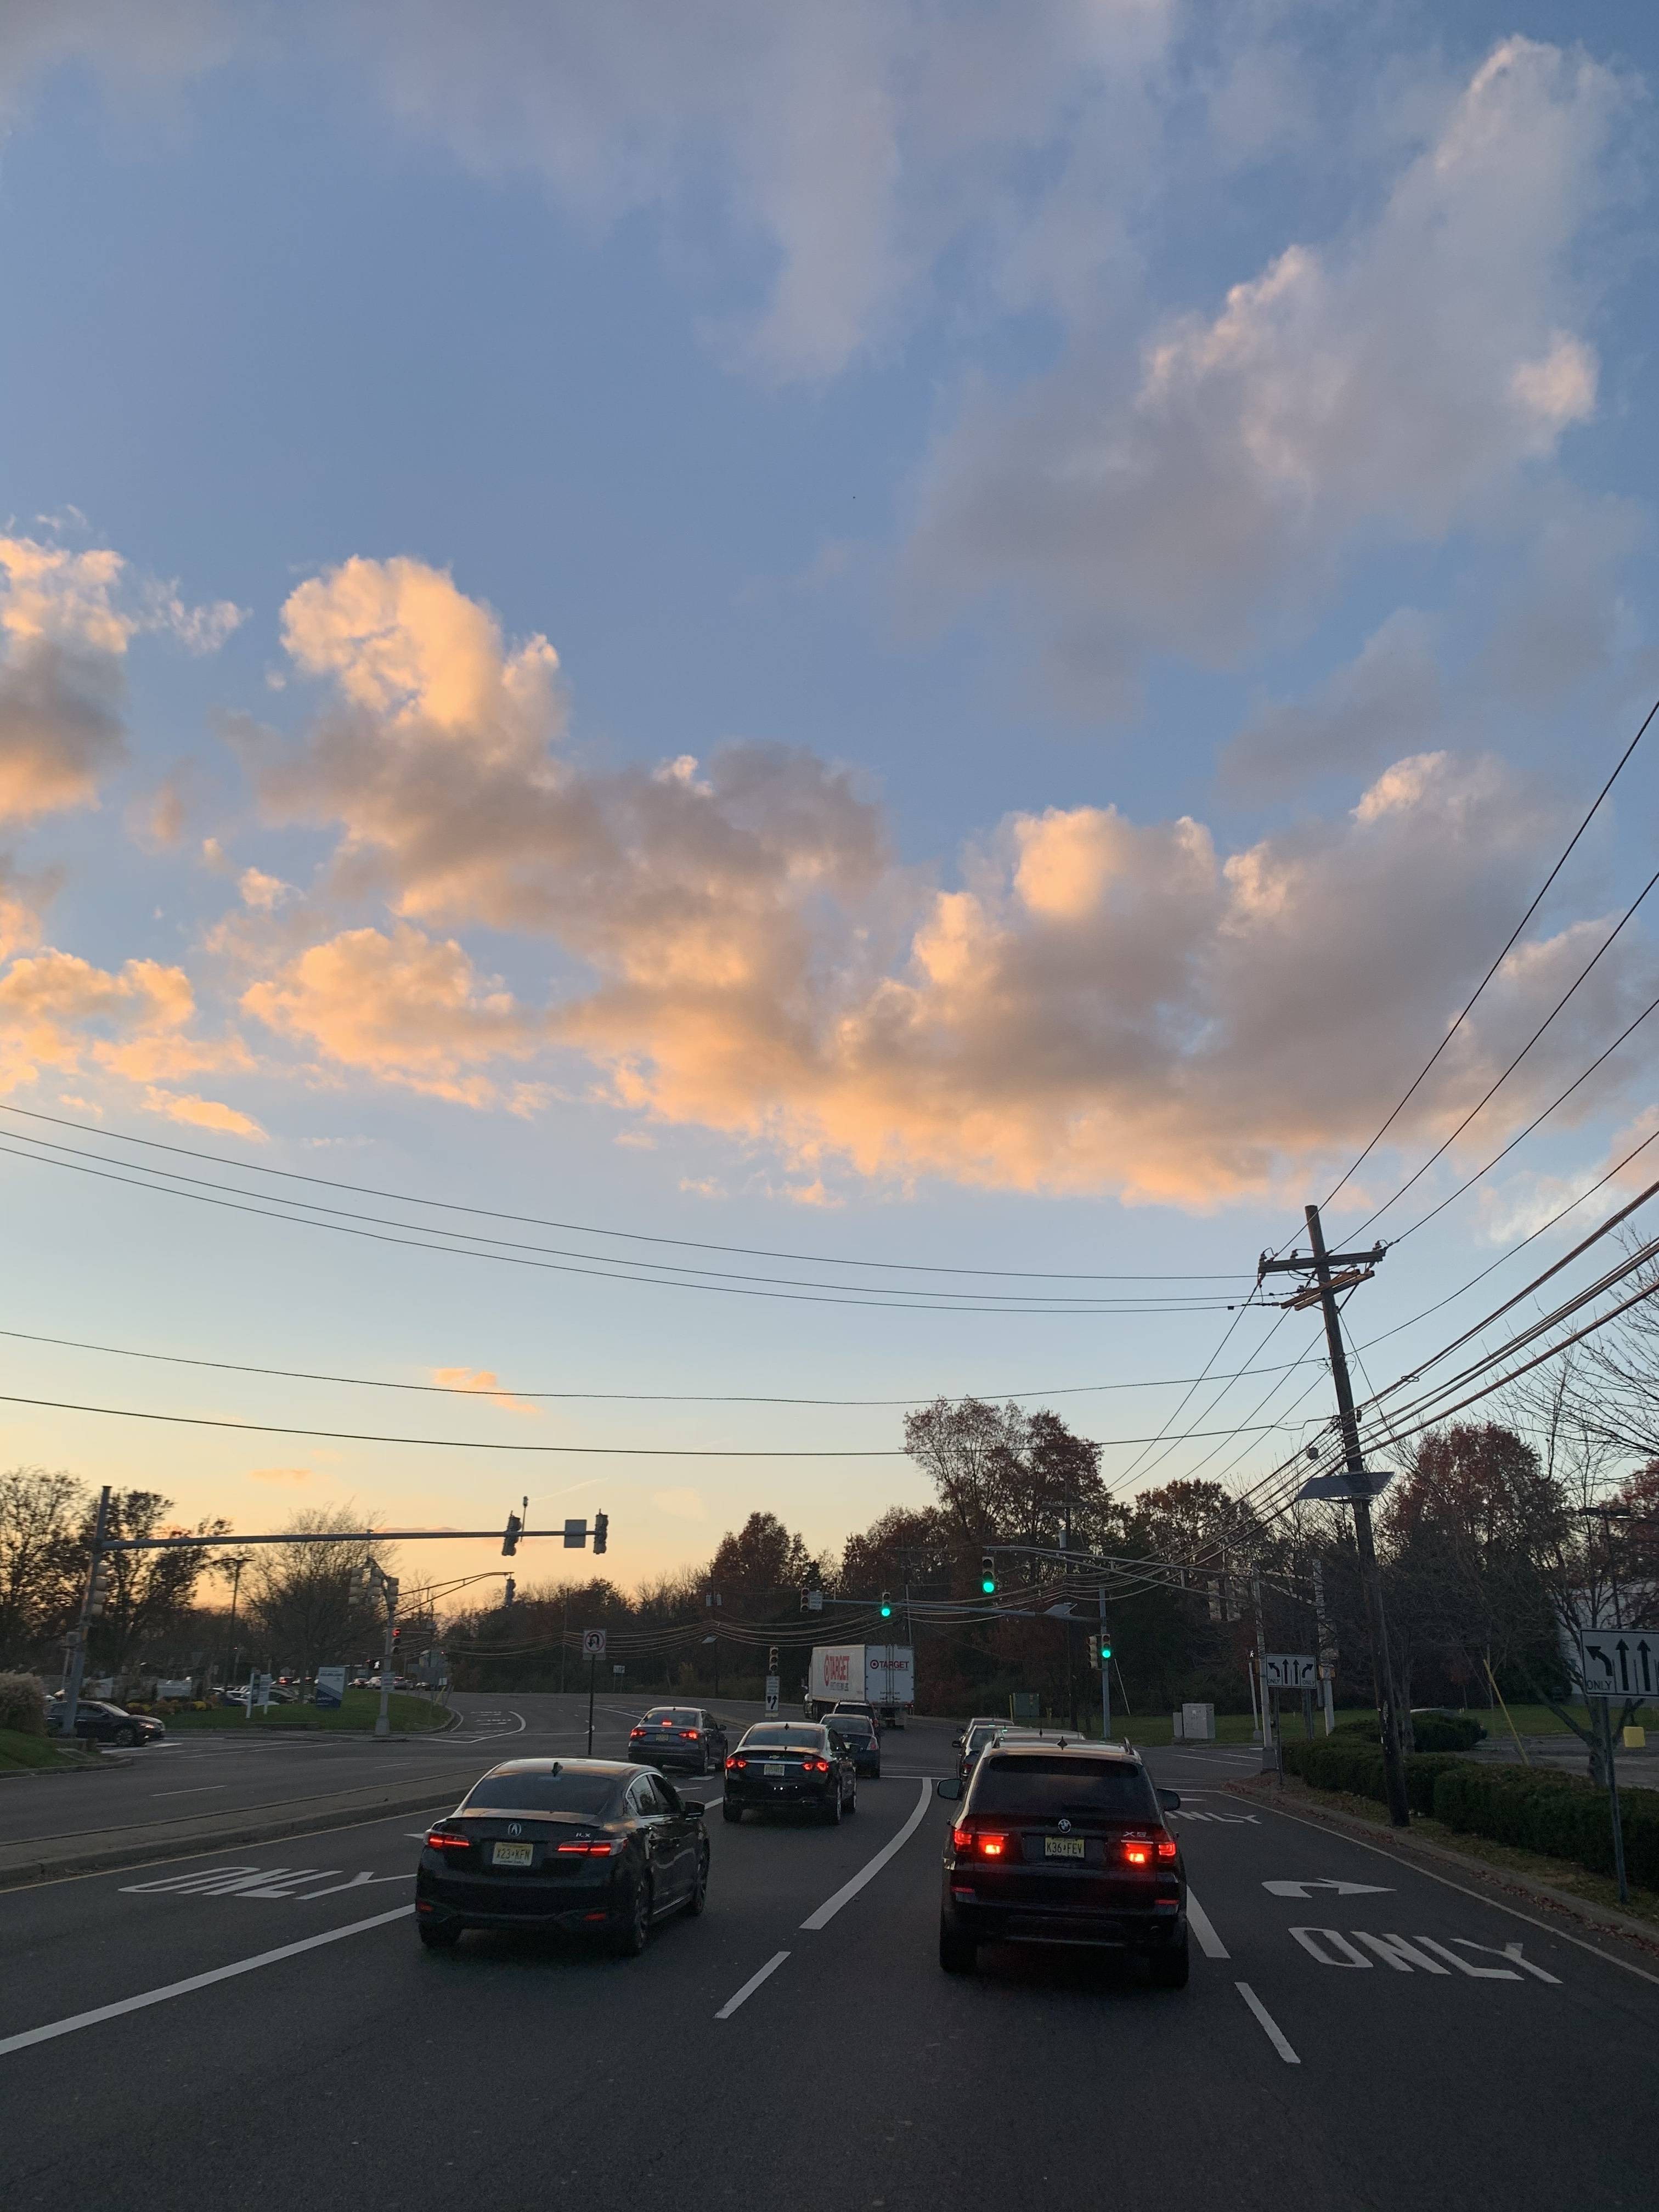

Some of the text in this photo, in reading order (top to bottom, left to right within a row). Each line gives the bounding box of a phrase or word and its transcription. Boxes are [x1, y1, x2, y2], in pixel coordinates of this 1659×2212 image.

[830, 1656, 850, 1680] TARGET
[1587, 1680, 1612, 1690] ONLY
[117, 1867, 417, 1900] ONLY
[1288, 1927, 1564, 1984] ONLY
